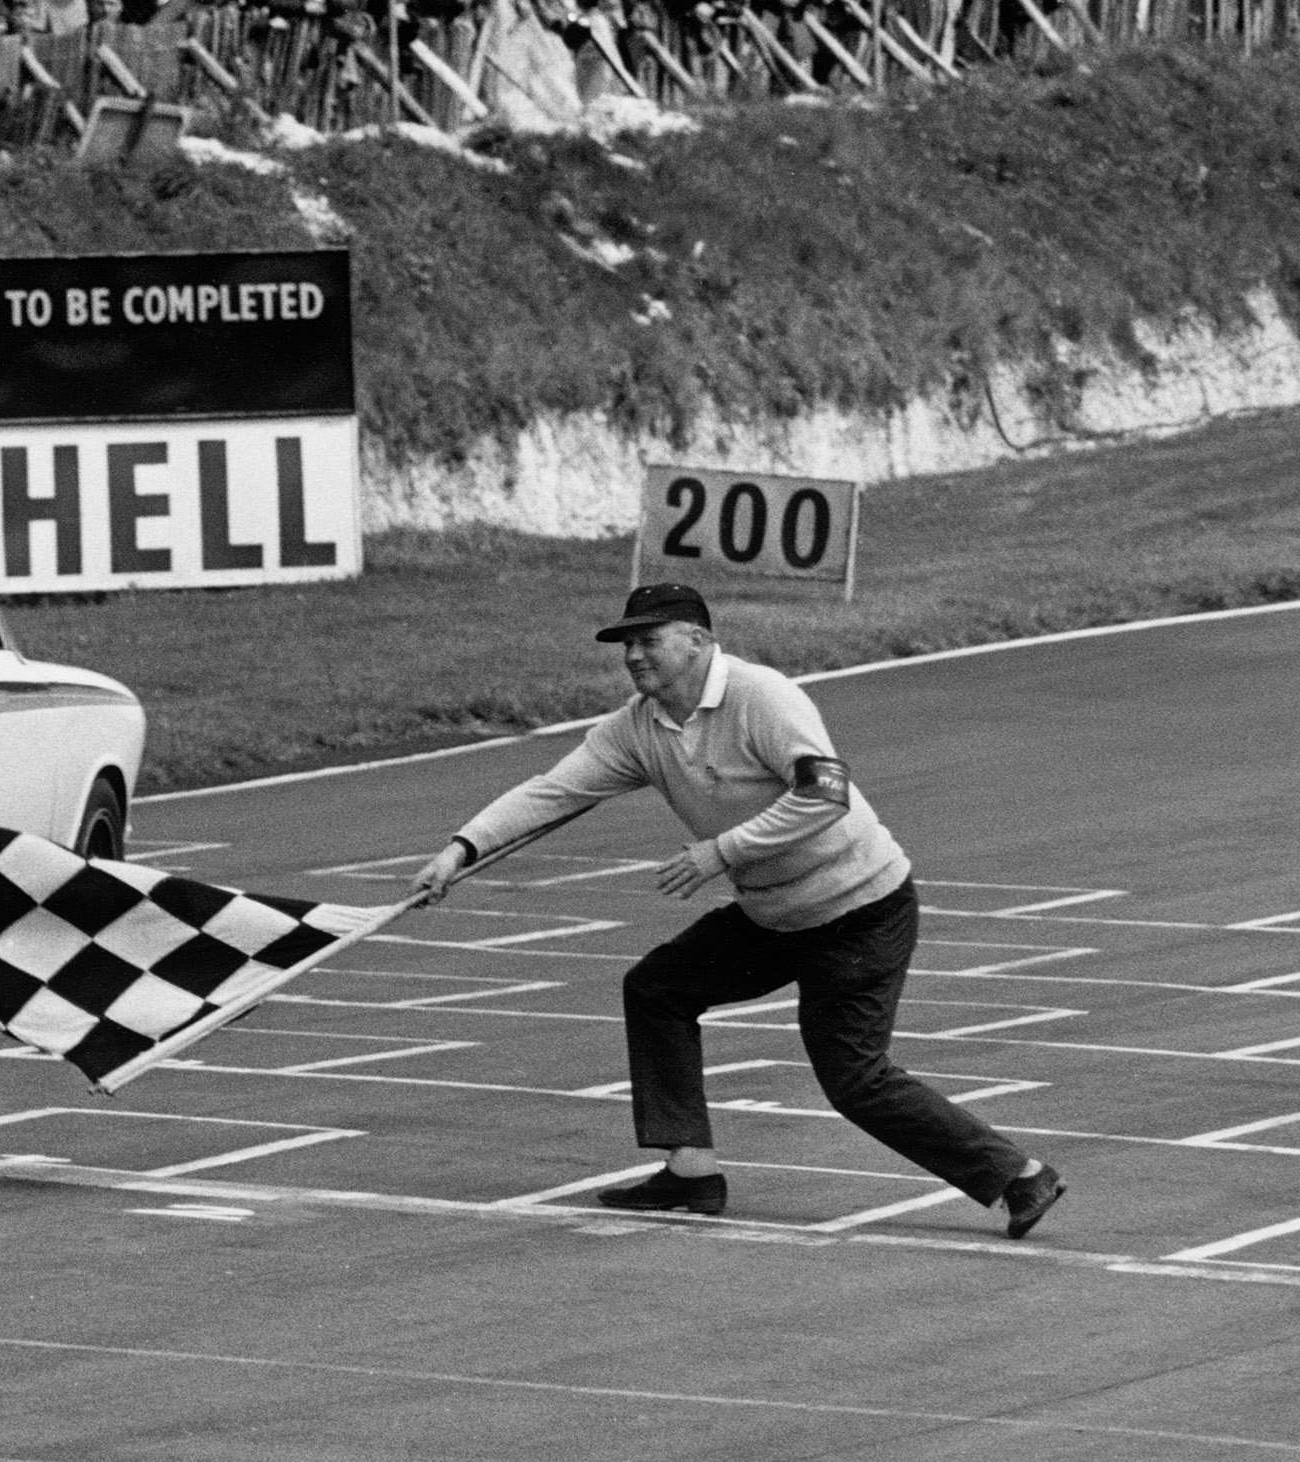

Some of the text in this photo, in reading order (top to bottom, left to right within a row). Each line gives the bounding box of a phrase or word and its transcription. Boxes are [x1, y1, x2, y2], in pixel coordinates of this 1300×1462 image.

[5, 289, 51, 326] TO
[66, 287, 111, 325] BE
[123, 283, 324, 323] COMPLETED
[663, 476, 830, 569] 200
